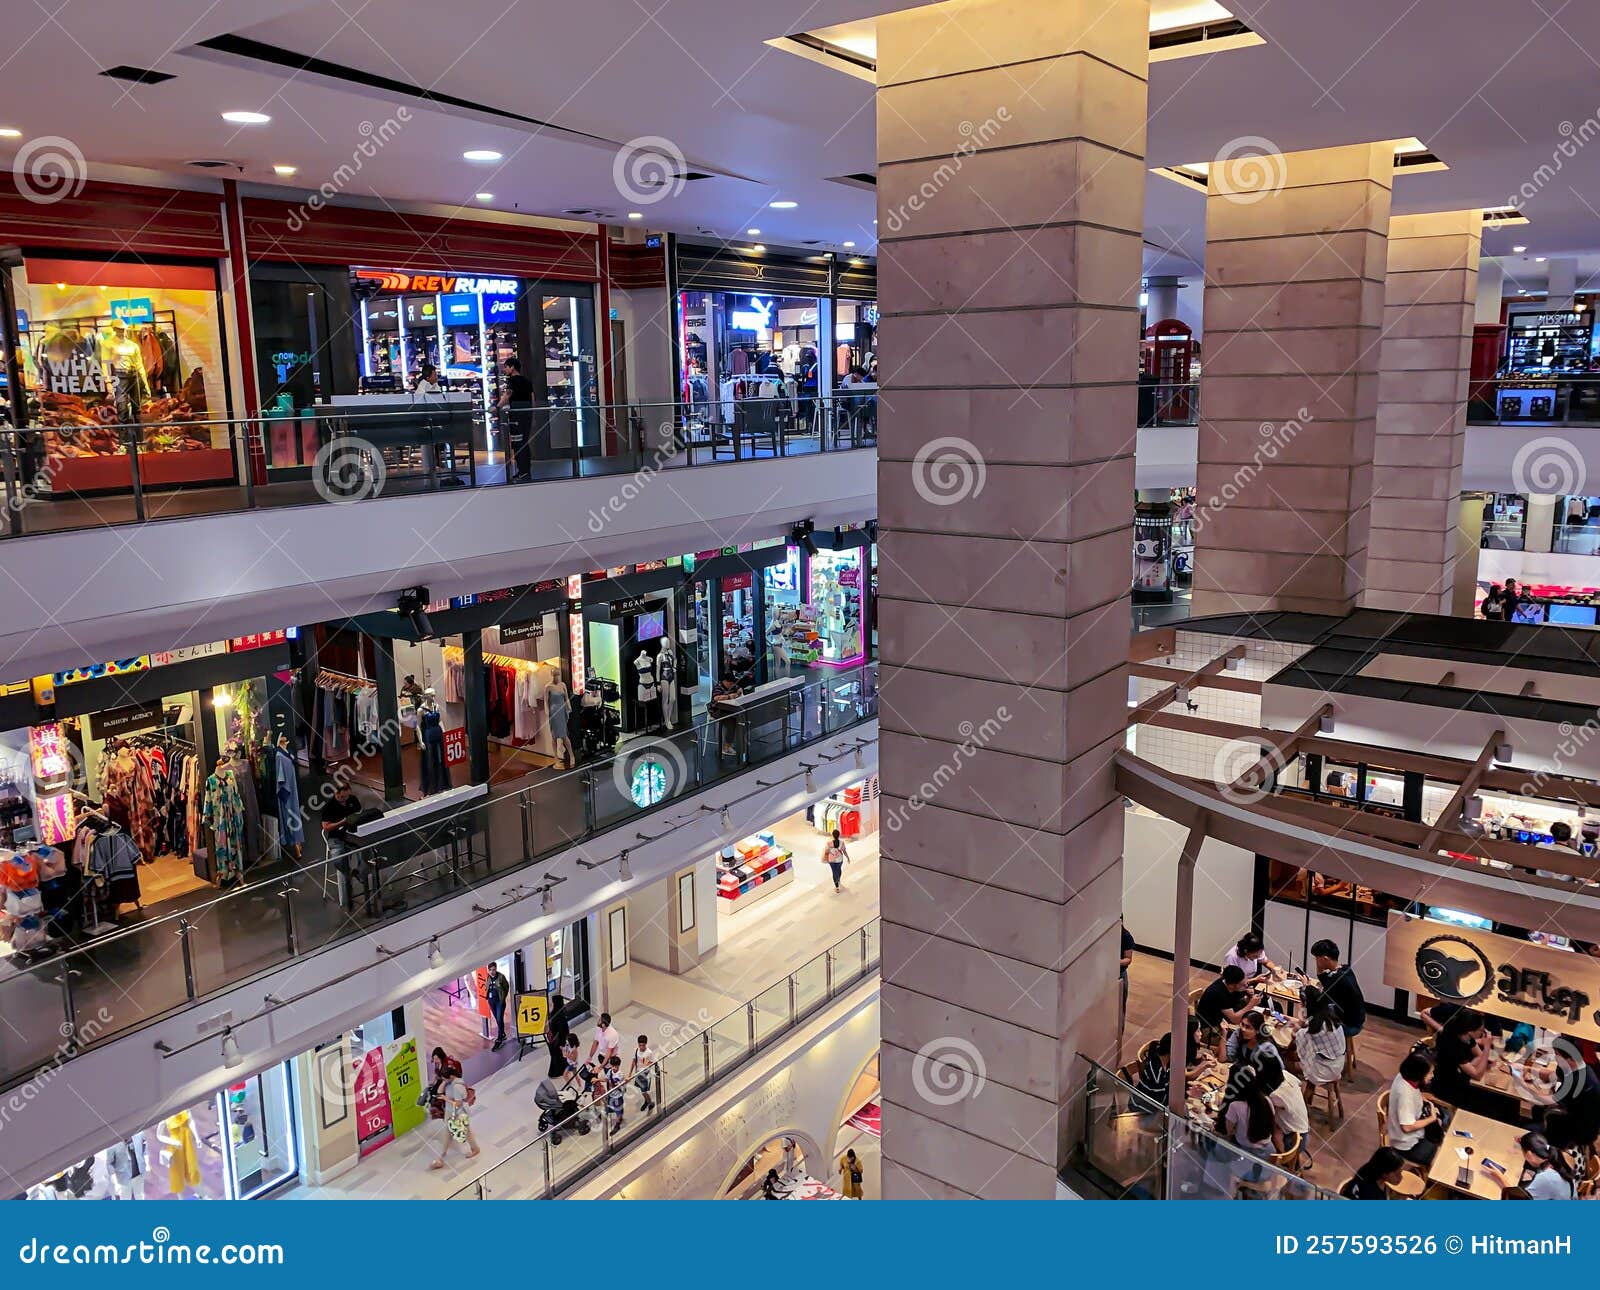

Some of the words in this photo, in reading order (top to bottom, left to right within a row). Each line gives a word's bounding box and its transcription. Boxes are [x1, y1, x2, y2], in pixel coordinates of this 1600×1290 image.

[48, 359, 116, 377] WHAT
[445, 731, 462, 743] SALE
[521, 1007, 541, 1023] 15
